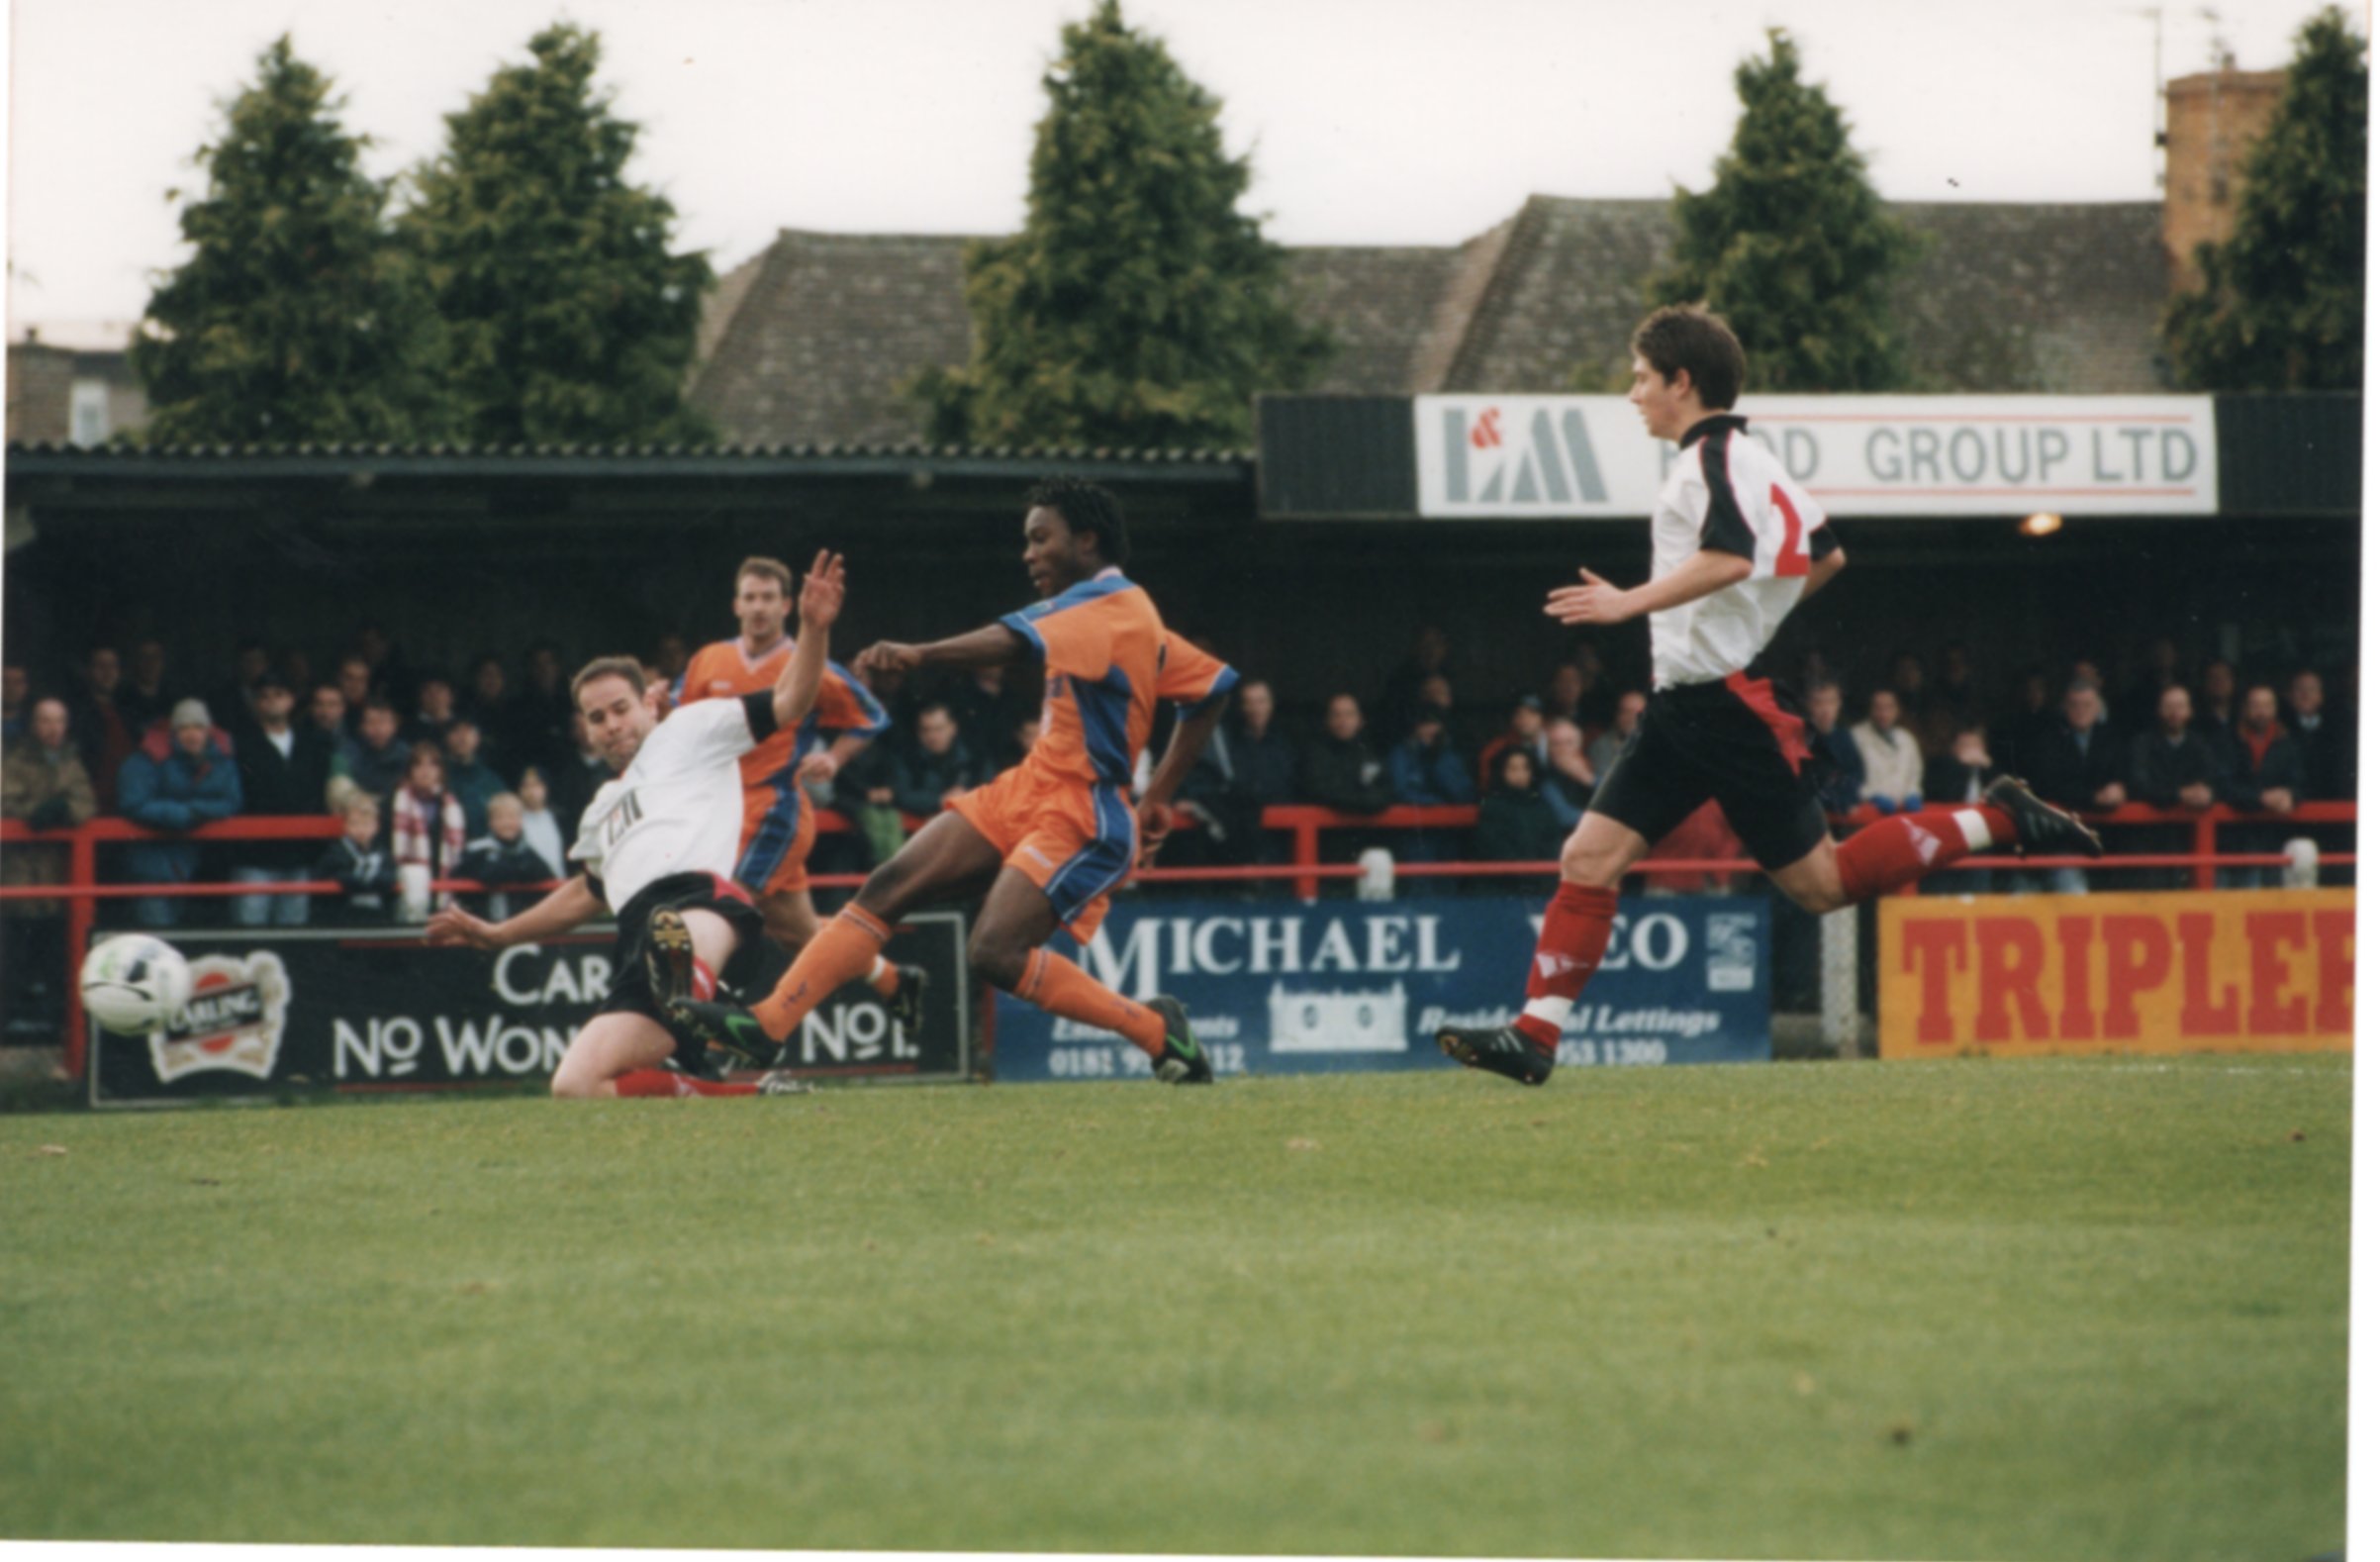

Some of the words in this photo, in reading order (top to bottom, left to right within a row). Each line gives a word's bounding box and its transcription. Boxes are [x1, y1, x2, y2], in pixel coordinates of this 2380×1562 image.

[1864, 426, 2070, 484] GROUP
[2091, 428, 2198, 482] LTD
[1077, 913, 1462, 1002] MICHAEL
[433, 1014, 582, 1075] WON
[1593, 1005, 1722, 1038] Lettings
